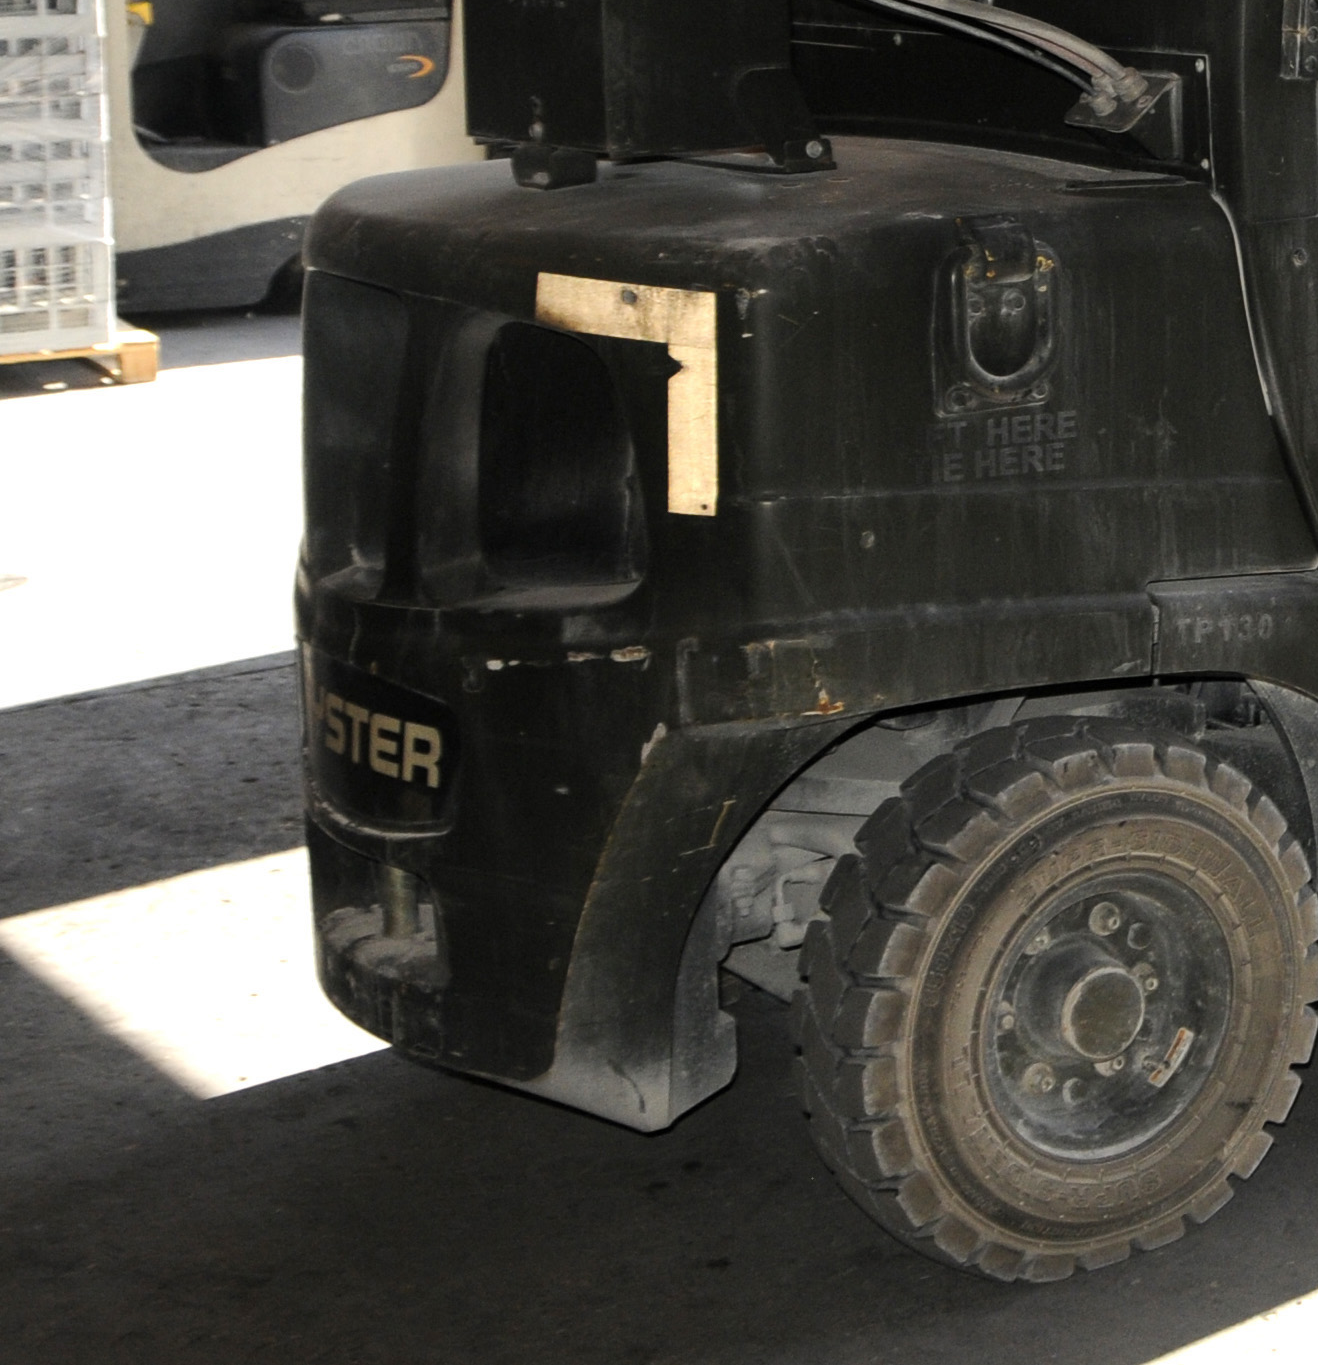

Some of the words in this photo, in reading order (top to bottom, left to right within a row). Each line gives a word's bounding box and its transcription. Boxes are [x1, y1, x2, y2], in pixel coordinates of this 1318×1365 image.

[986, 409, 1079, 446] HERE
[975, 441, 1066, 479] HERE
[312, 684, 442, 790] YSTER
